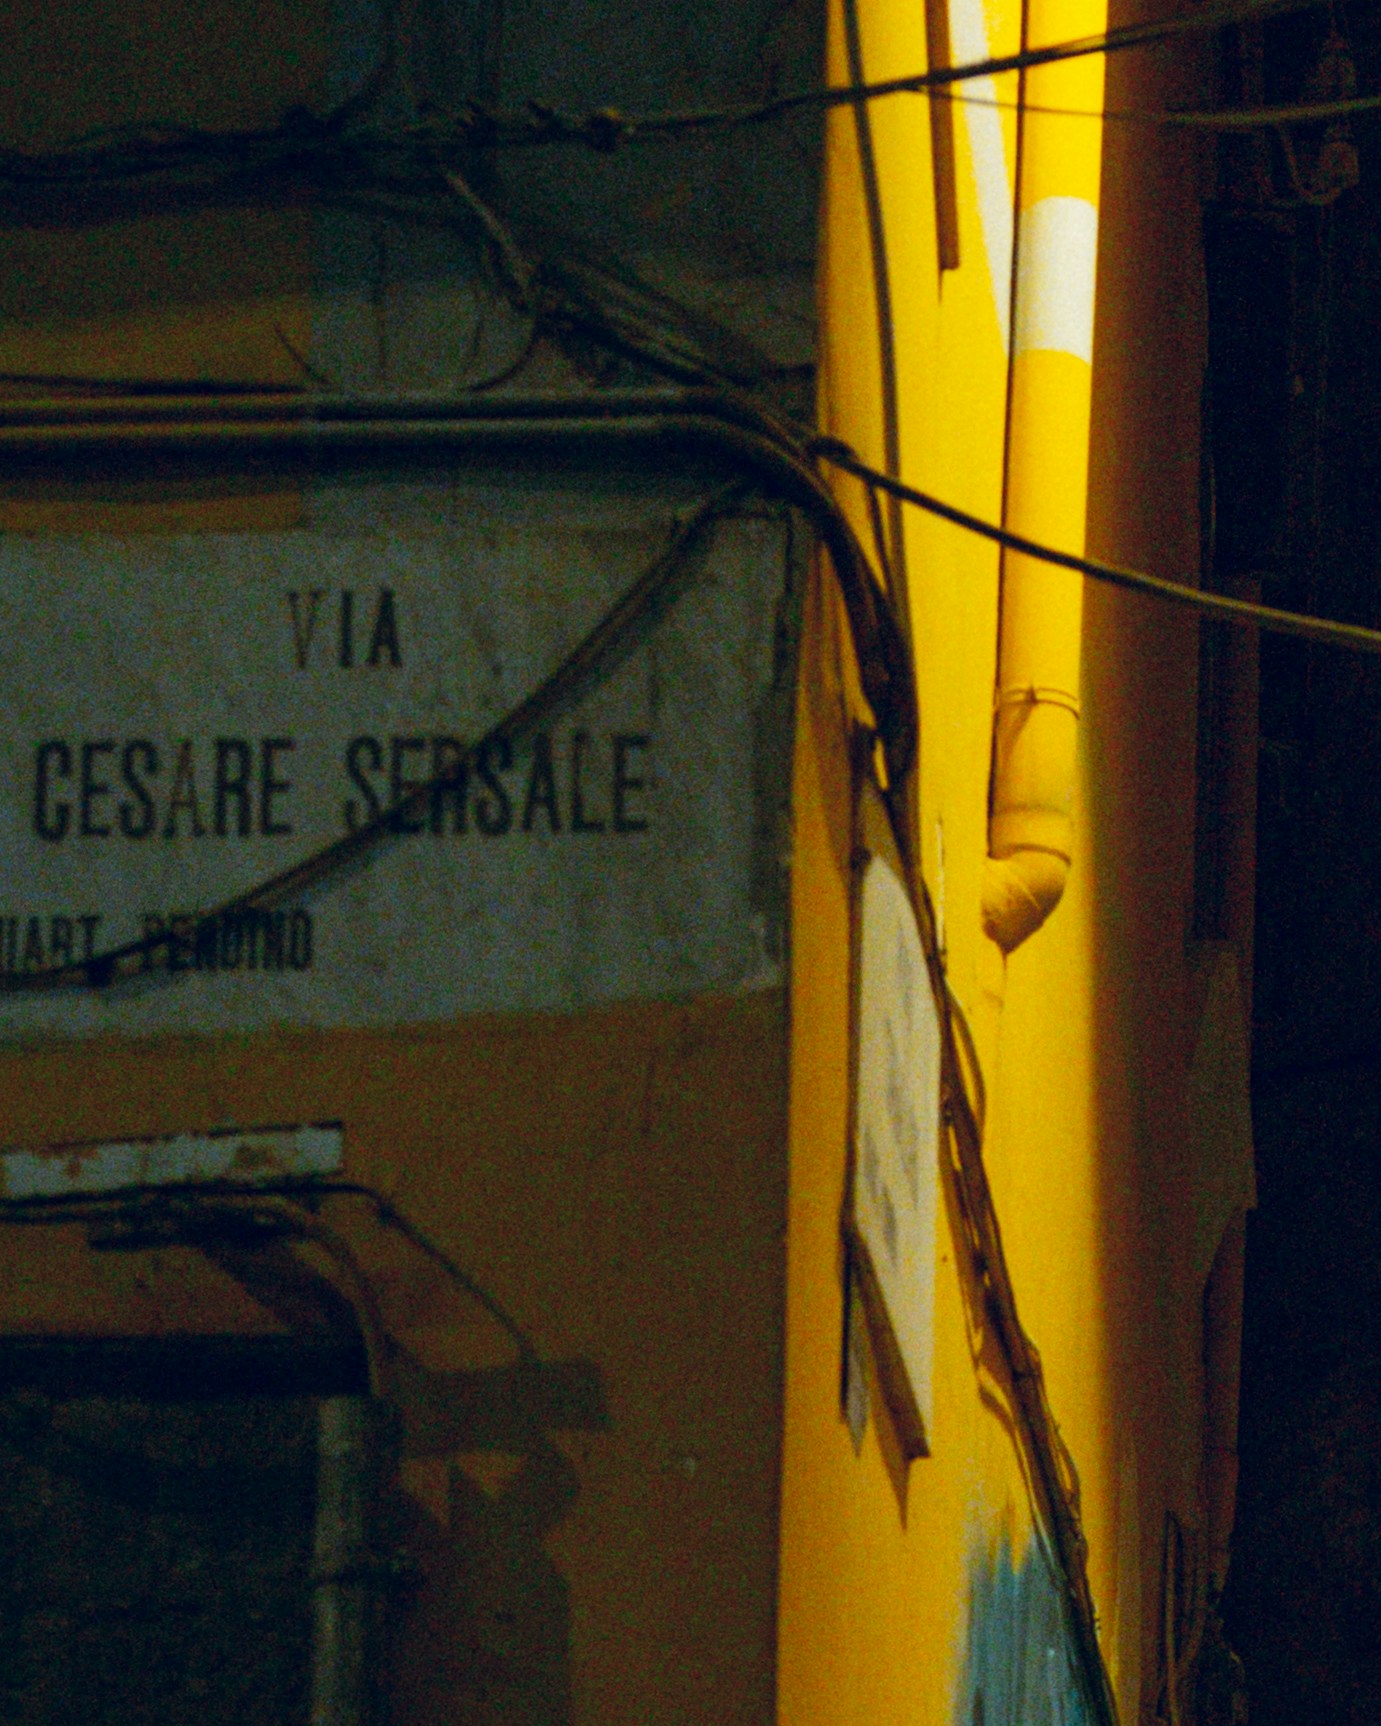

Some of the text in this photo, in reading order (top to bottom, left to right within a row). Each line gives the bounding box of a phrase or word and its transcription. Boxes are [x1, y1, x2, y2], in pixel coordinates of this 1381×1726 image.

[289, 588, 400, 668] VIA
[33, 734, 653, 842] CESARE SERSALE
